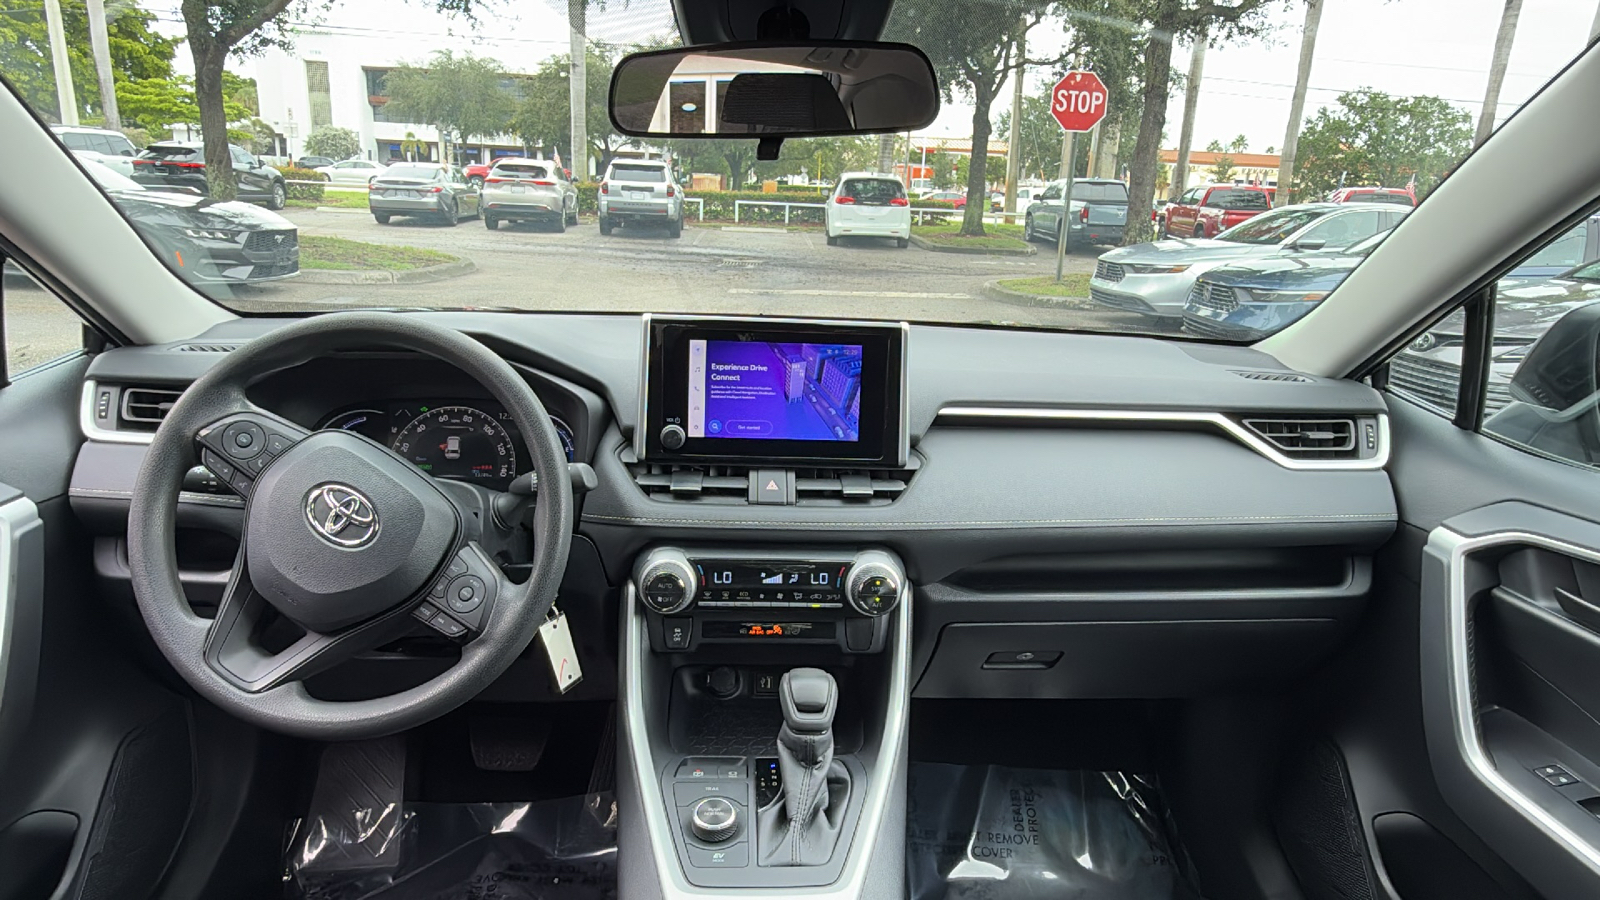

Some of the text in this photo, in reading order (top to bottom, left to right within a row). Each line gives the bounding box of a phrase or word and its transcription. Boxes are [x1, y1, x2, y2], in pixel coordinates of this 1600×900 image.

[1055, 89, 1104, 114] STOP
[711, 363, 749, 371] Experience
[711, 373, 740, 381] Connect
[438, 414, 449, 423] 60
[462, 414, 473, 423] 80
[416, 424, 426, 433] 40
[482, 424, 495, 436] 100
[400, 442, 410, 453] 20
[496, 442, 507, 456] 120
[500, 464, 508, 478] 140
[1010, 789, 1024, 831] DEALER
[988, 832, 1039, 846] REMOVE
[973, 846, 1013, 858] COVER
